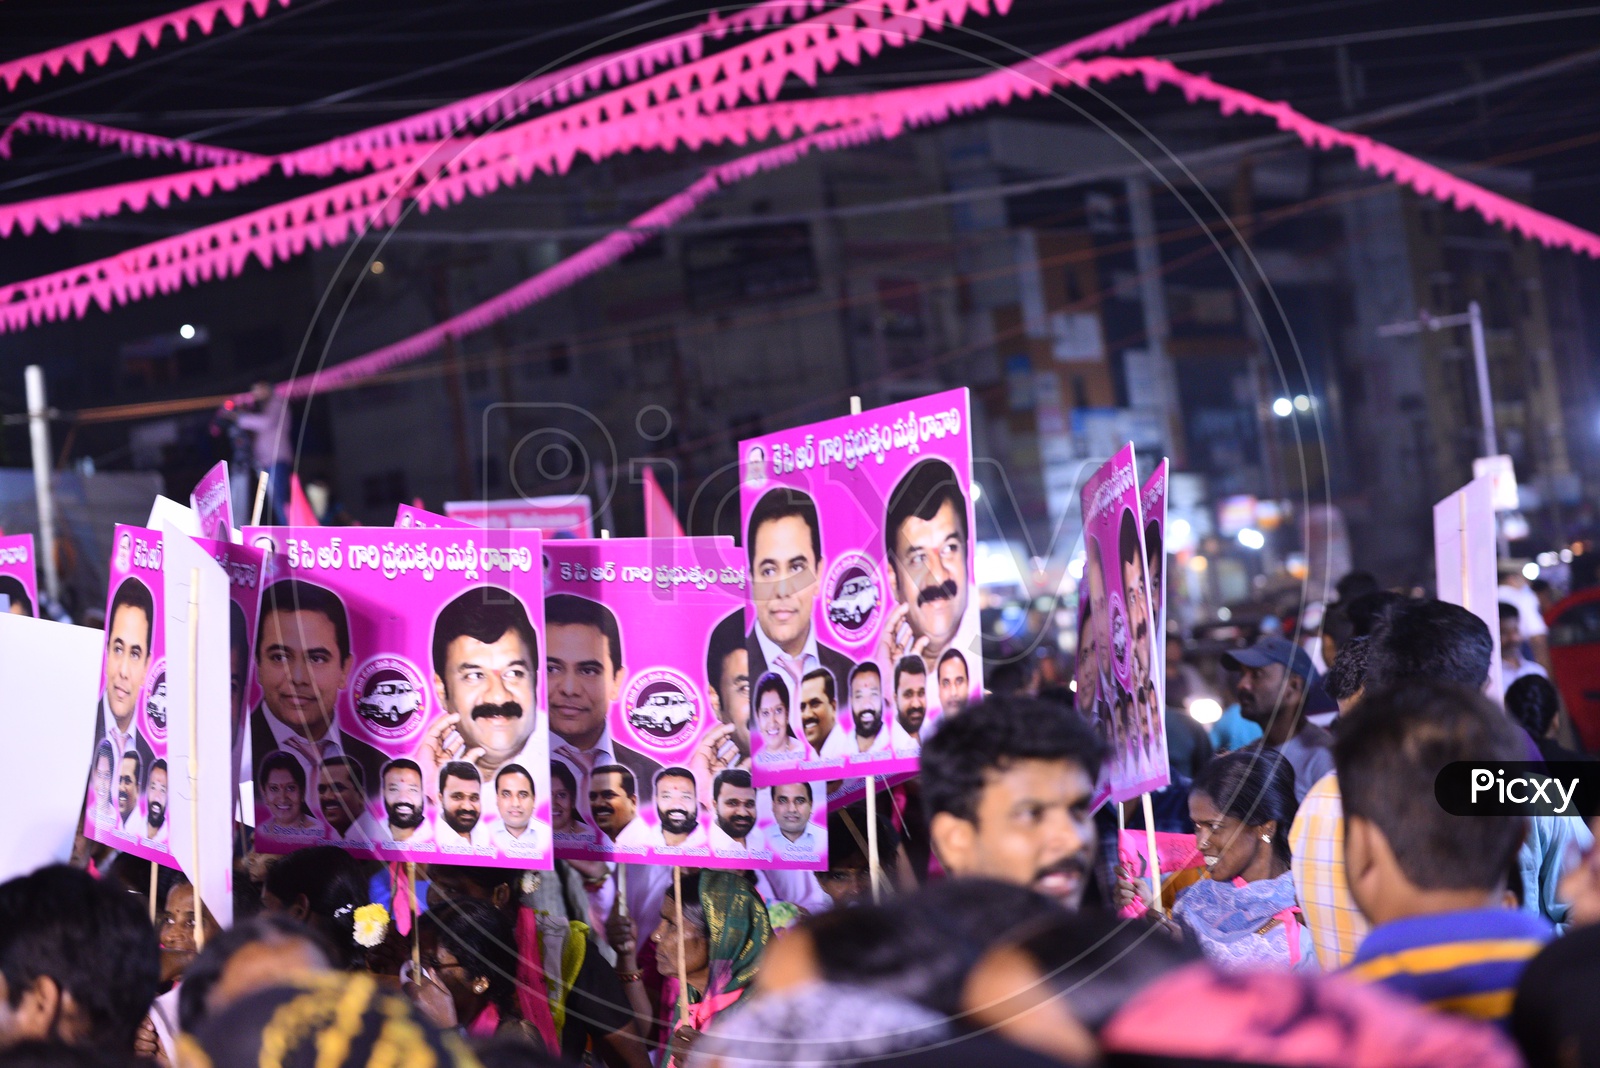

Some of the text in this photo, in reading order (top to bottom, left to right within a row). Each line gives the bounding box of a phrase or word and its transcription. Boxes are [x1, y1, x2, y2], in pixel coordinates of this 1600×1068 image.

[919, 407, 961, 443] రావాలి
[348, 544, 380, 570] గారి
[381, 541, 444, 582] ప్రభుత్వం
[480, 546, 533, 573] రావాలి
[621, 566, 653, 583] గారి
